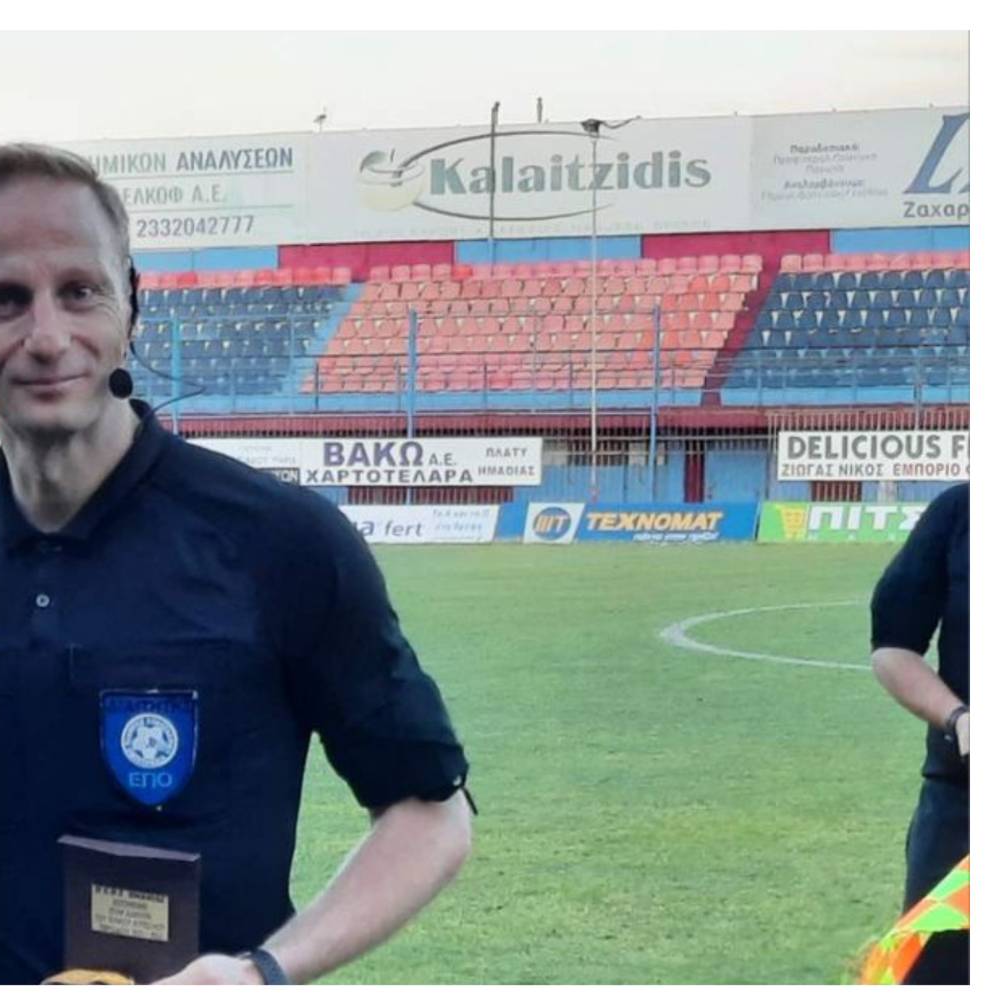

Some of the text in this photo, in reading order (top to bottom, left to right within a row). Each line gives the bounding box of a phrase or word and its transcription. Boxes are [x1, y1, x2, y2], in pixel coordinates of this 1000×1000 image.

[176, 148, 293, 171] ΑΝΑΛΥΣΕΩΝ
[903, 110, 970, 194] L
[430, 150, 711, 195] Kalaitzidis
[137, 214, 254, 239] 2332042777
[323, 441, 457, 467] ΒΑΚΩ Α.Ε.
[485, 447, 528, 458] ΠΛΑΤΥ
[787, 435, 970, 460] DELICIOUS F
[306, 469, 474, 484] ΧΑΡΤΟΤΕΛΑΡΑ
[478, 465, 535, 477] ΗΜΑΘΙΑΣ
[838, 463, 884, 476] ΝΙΚΟΣ
[893, 462, 961, 476] ΕΜΠΟΡΙΟ
[353, 519, 423, 537] a fert
[586, 511, 723, 532] ΤΕΧΝΟΜΑΤ
[128, 772, 173, 788] ΕΠΟ
